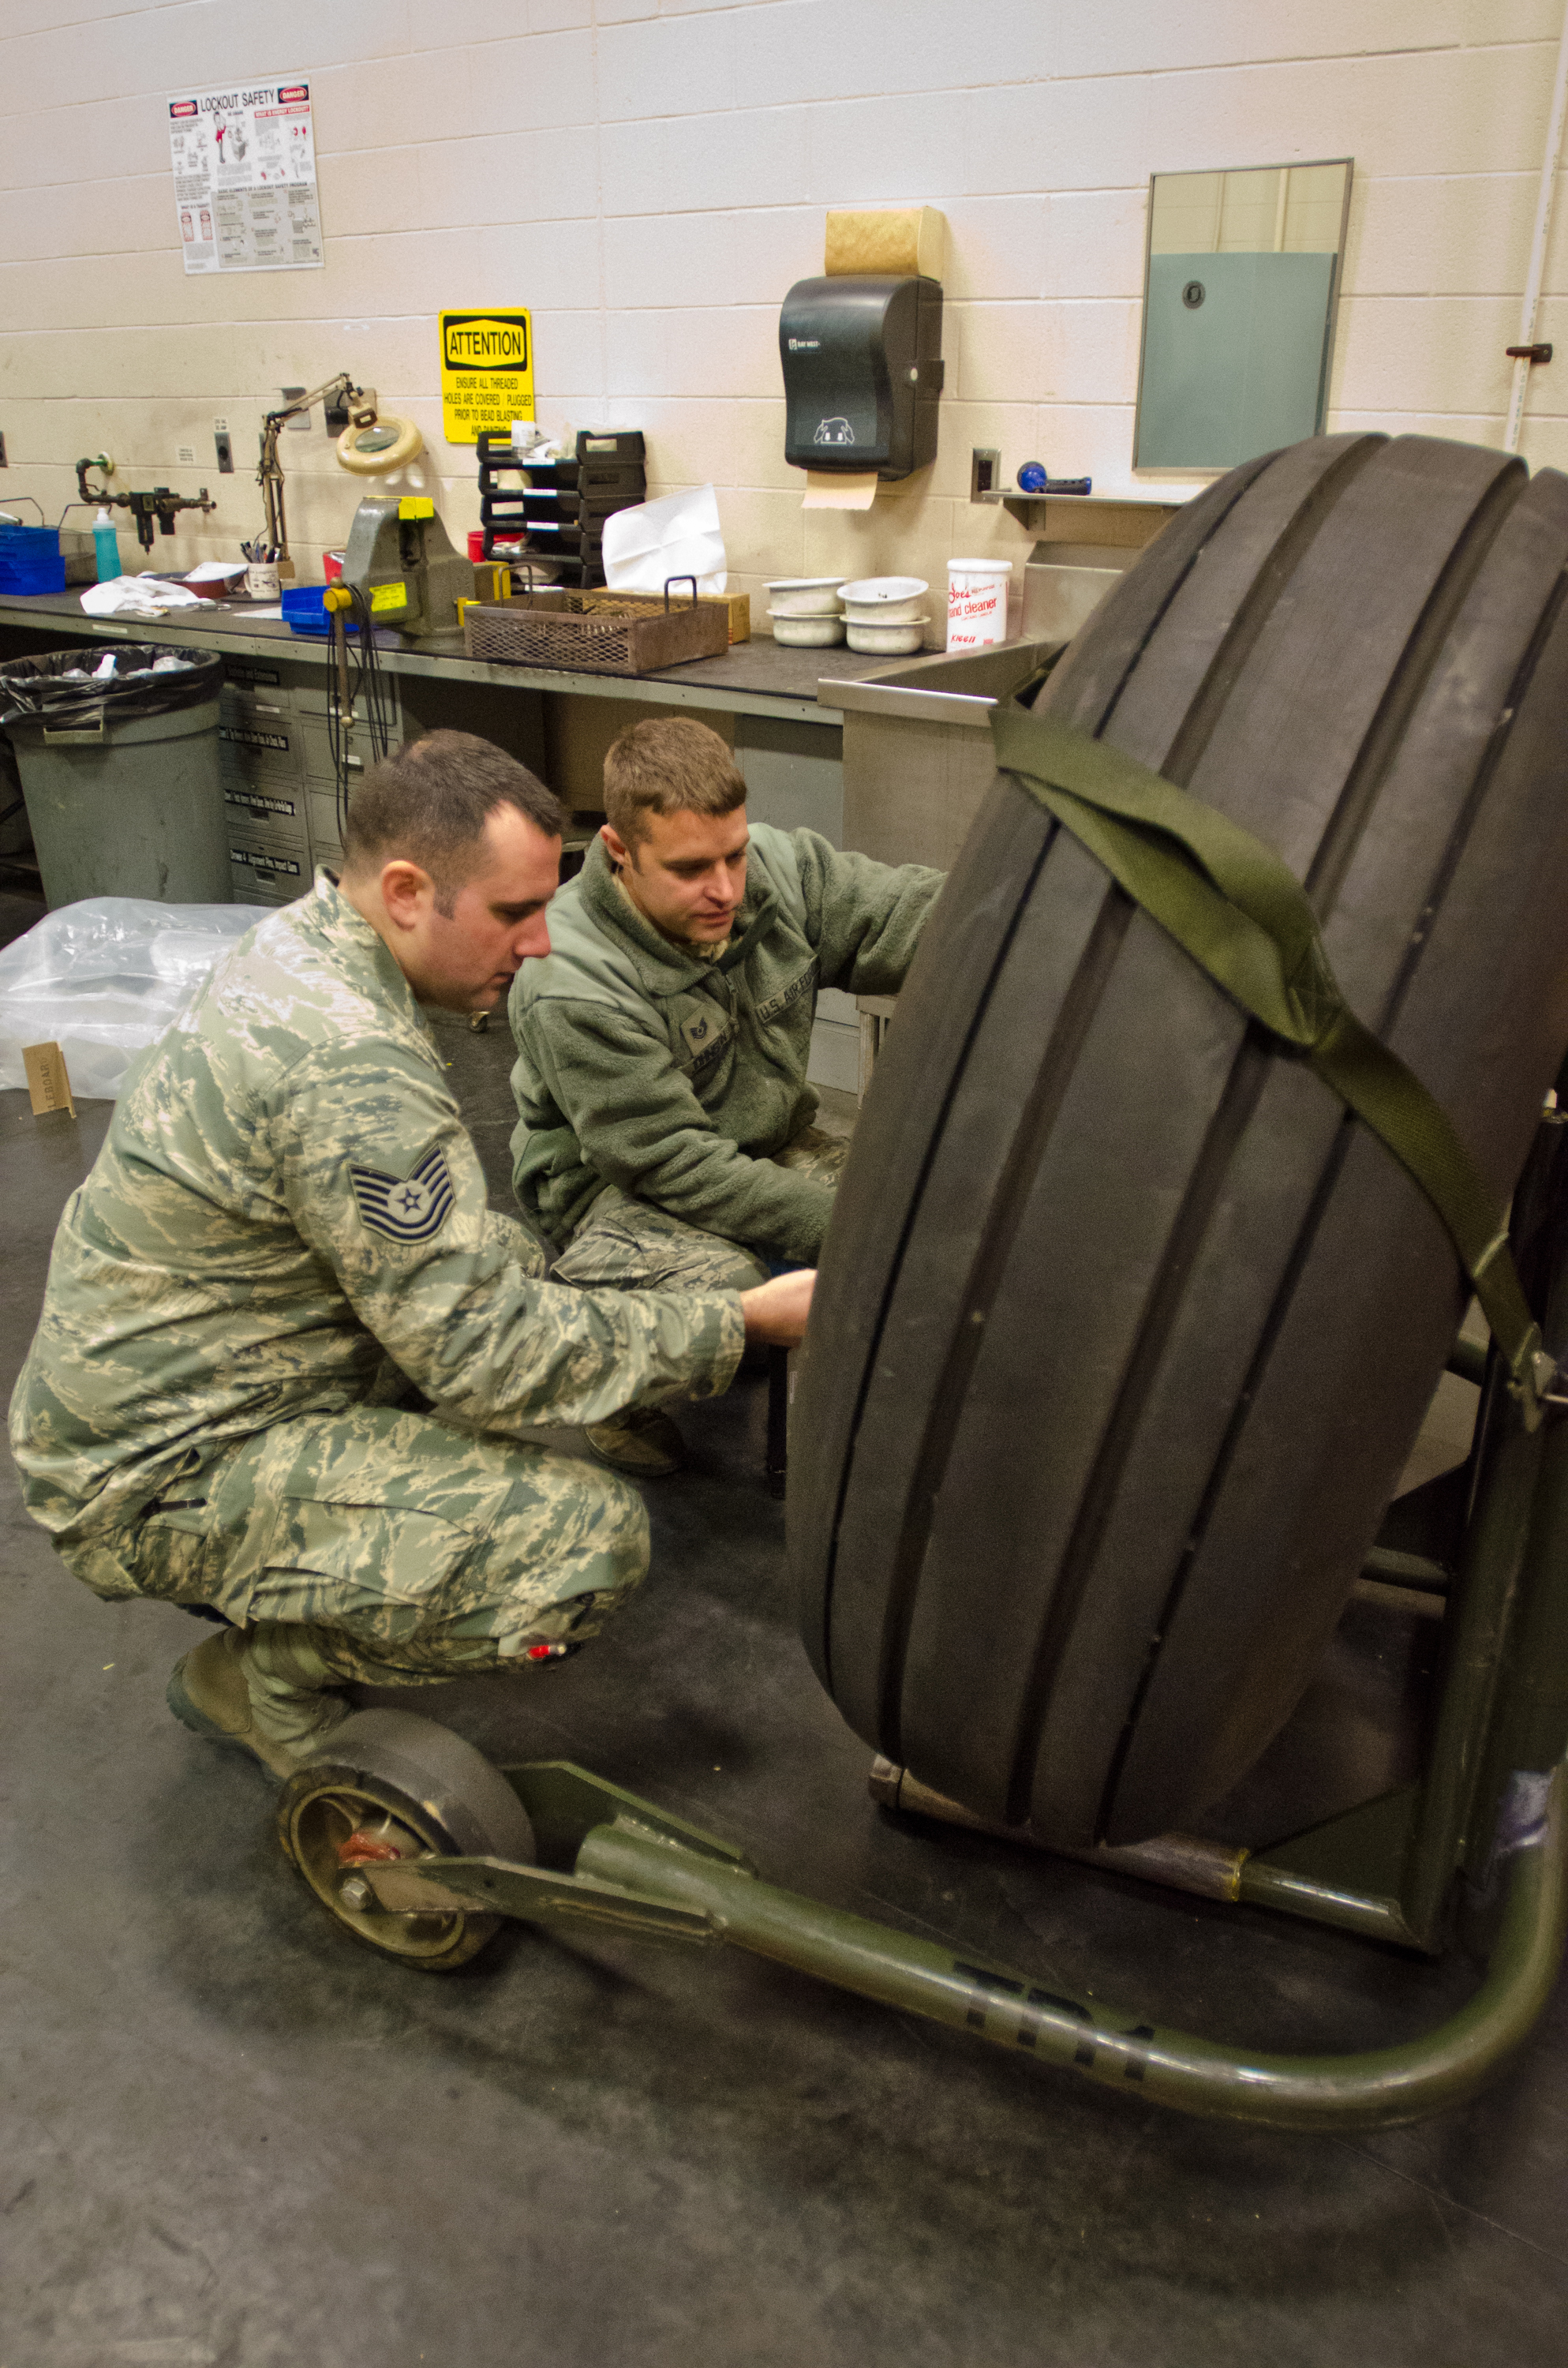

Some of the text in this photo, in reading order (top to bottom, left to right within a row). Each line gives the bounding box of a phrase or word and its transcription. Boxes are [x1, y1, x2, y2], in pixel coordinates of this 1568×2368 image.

[200, 89, 275, 112] LOCKOUT SAFETY
[282, 91, 305, 99] DANGER
[174, 105, 193, 114] DANGER
[450, 332, 521, 355] ATTENTION
[456, 377, 518, 390] ENSURE ALL THREADED
[443, 392, 462, 404] HOLES
[463, 393, 473, 405] ARE
[475, 393, 500, 405] COVERED
[507, 394, 532, 407] PLUGGED
[455, 408, 522, 422] PRIOR TO BEAD BLASTING
[964, 597, 997, 614] cleaner
[783, 983, 799, 1003] AIR
